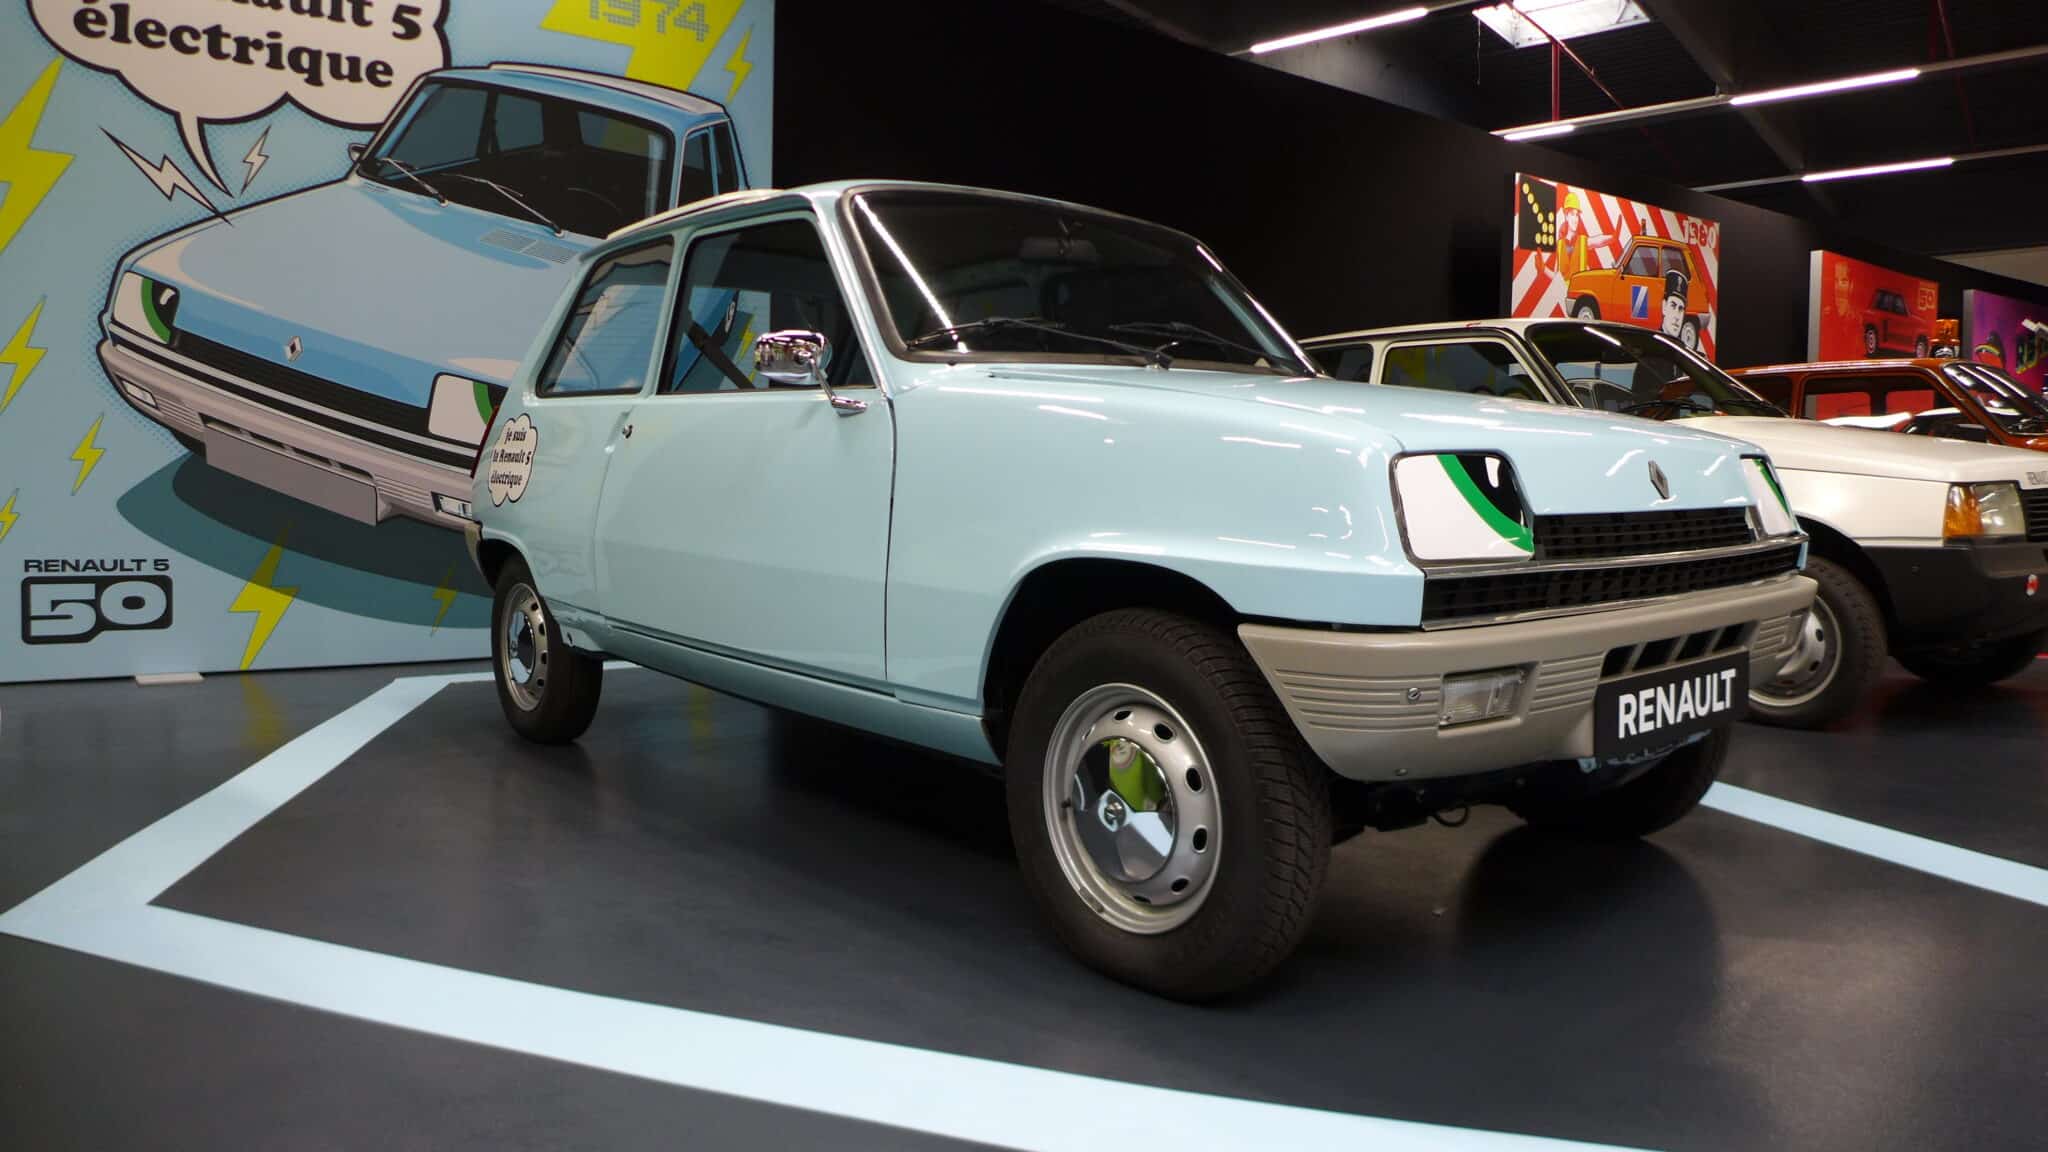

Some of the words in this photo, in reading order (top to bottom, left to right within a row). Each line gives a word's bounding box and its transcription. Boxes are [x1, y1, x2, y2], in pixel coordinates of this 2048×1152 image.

[391, 3, 423, 41] 5
[73, 0, 393, 88] électrique
[512, 427, 528, 441] suis
[500, 449, 526, 463] Renault
[525, 451, 532, 465] 5
[490, 470, 522, 489] électrique
[24, 558, 147, 573] RENAULT
[153, 558, 170, 572] 5
[29, 579, 168, 637] 50
[1618, 667, 1737, 739] RENAULT
